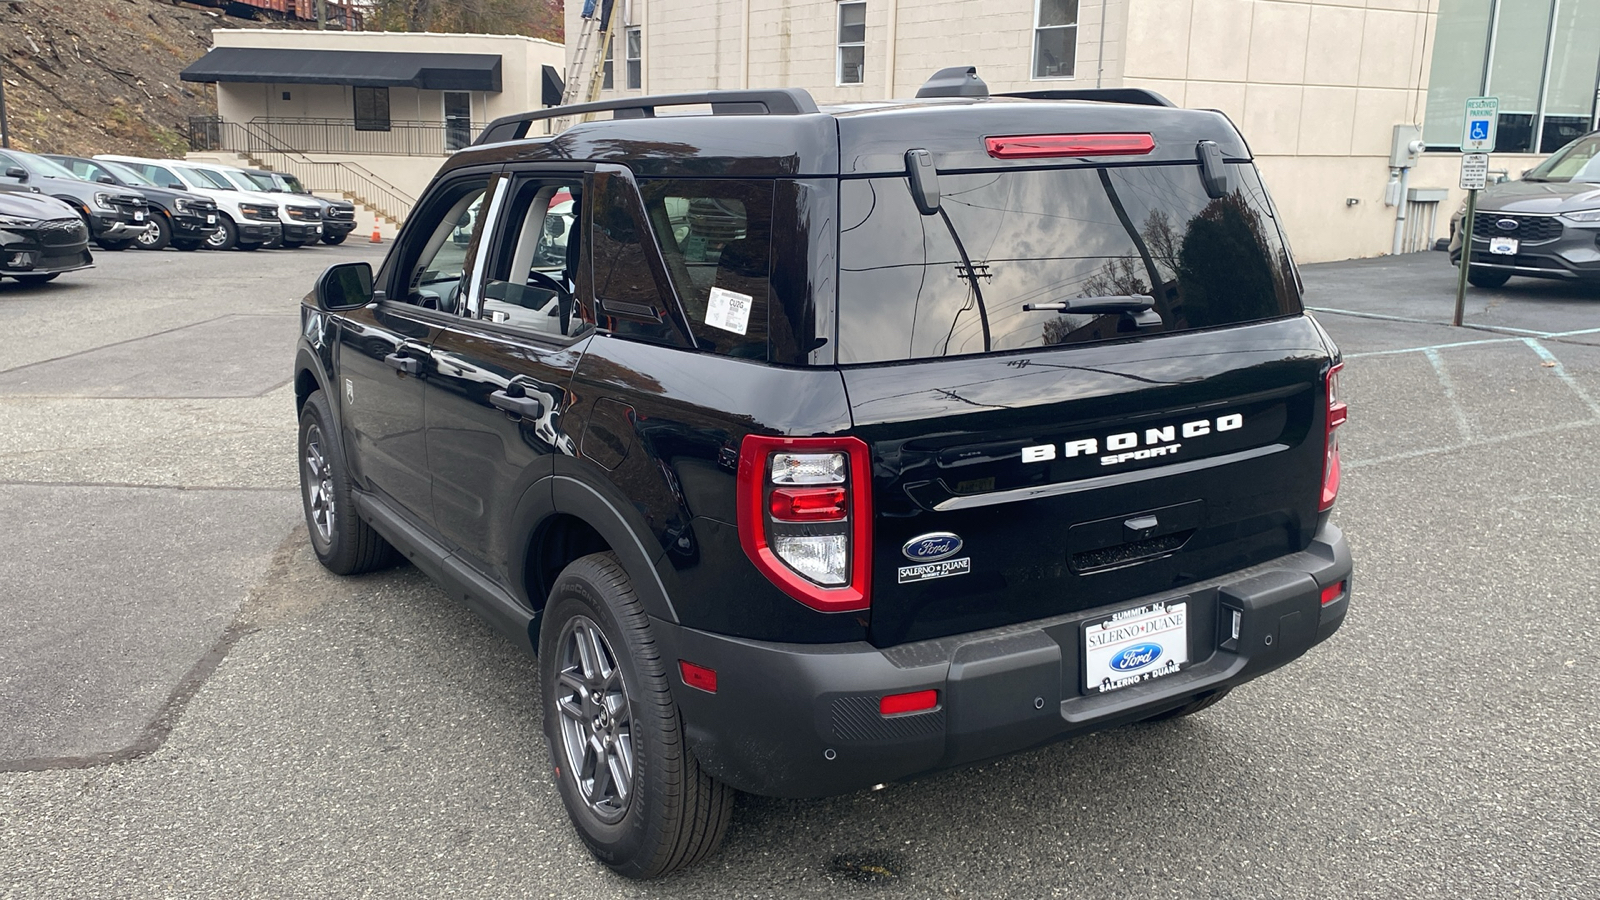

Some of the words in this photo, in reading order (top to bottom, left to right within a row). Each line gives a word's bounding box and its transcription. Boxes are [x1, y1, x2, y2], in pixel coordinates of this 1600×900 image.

[1467, 101, 1497, 109] RESERVED
[1470, 109, 1493, 117] PARKING
[1021, 413, 1243, 464] BRONCO
[1100, 443, 1182, 466] SPORT
[917, 538, 951, 556] Ford
[900, 565, 936, 578] SALERNO
[942, 559, 968, 571] DUANE
[1152, 601, 1165, 611] NJ
[1088, 625, 1140, 648] SALERNO
[1145, 613, 1184, 633] DUANE
[1119, 646, 1153, 669] Ford
[1099, 675, 1140, 693] SALERNO
[1152, 663, 1181, 679] DUANE
